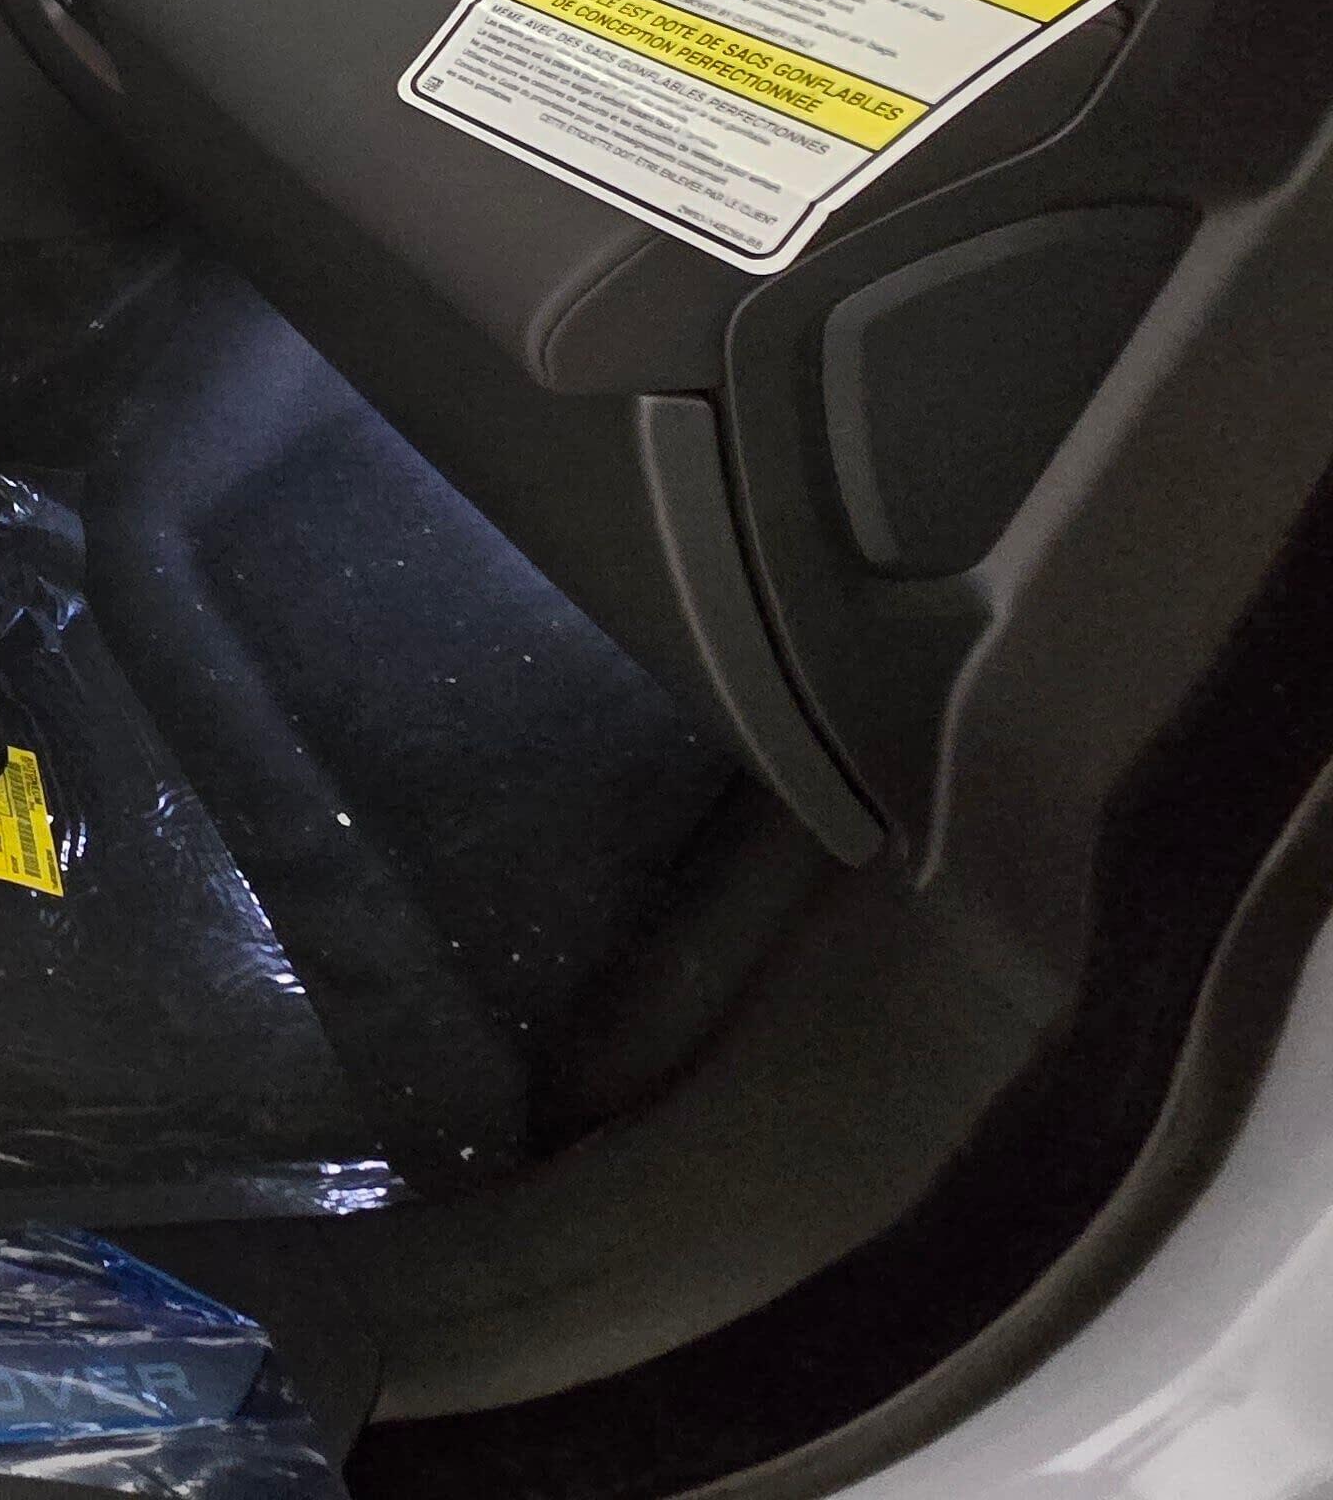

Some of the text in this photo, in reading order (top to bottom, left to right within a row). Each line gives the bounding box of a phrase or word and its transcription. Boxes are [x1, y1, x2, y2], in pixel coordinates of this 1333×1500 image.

[573, 5, 678, 53] CONCEPTION
[617, 2, 654, 21] EST
[694, 32, 726, 50] DE
[720, 43, 776, 69] SACS
[770, 62, 906, 121] GONFLABLES
